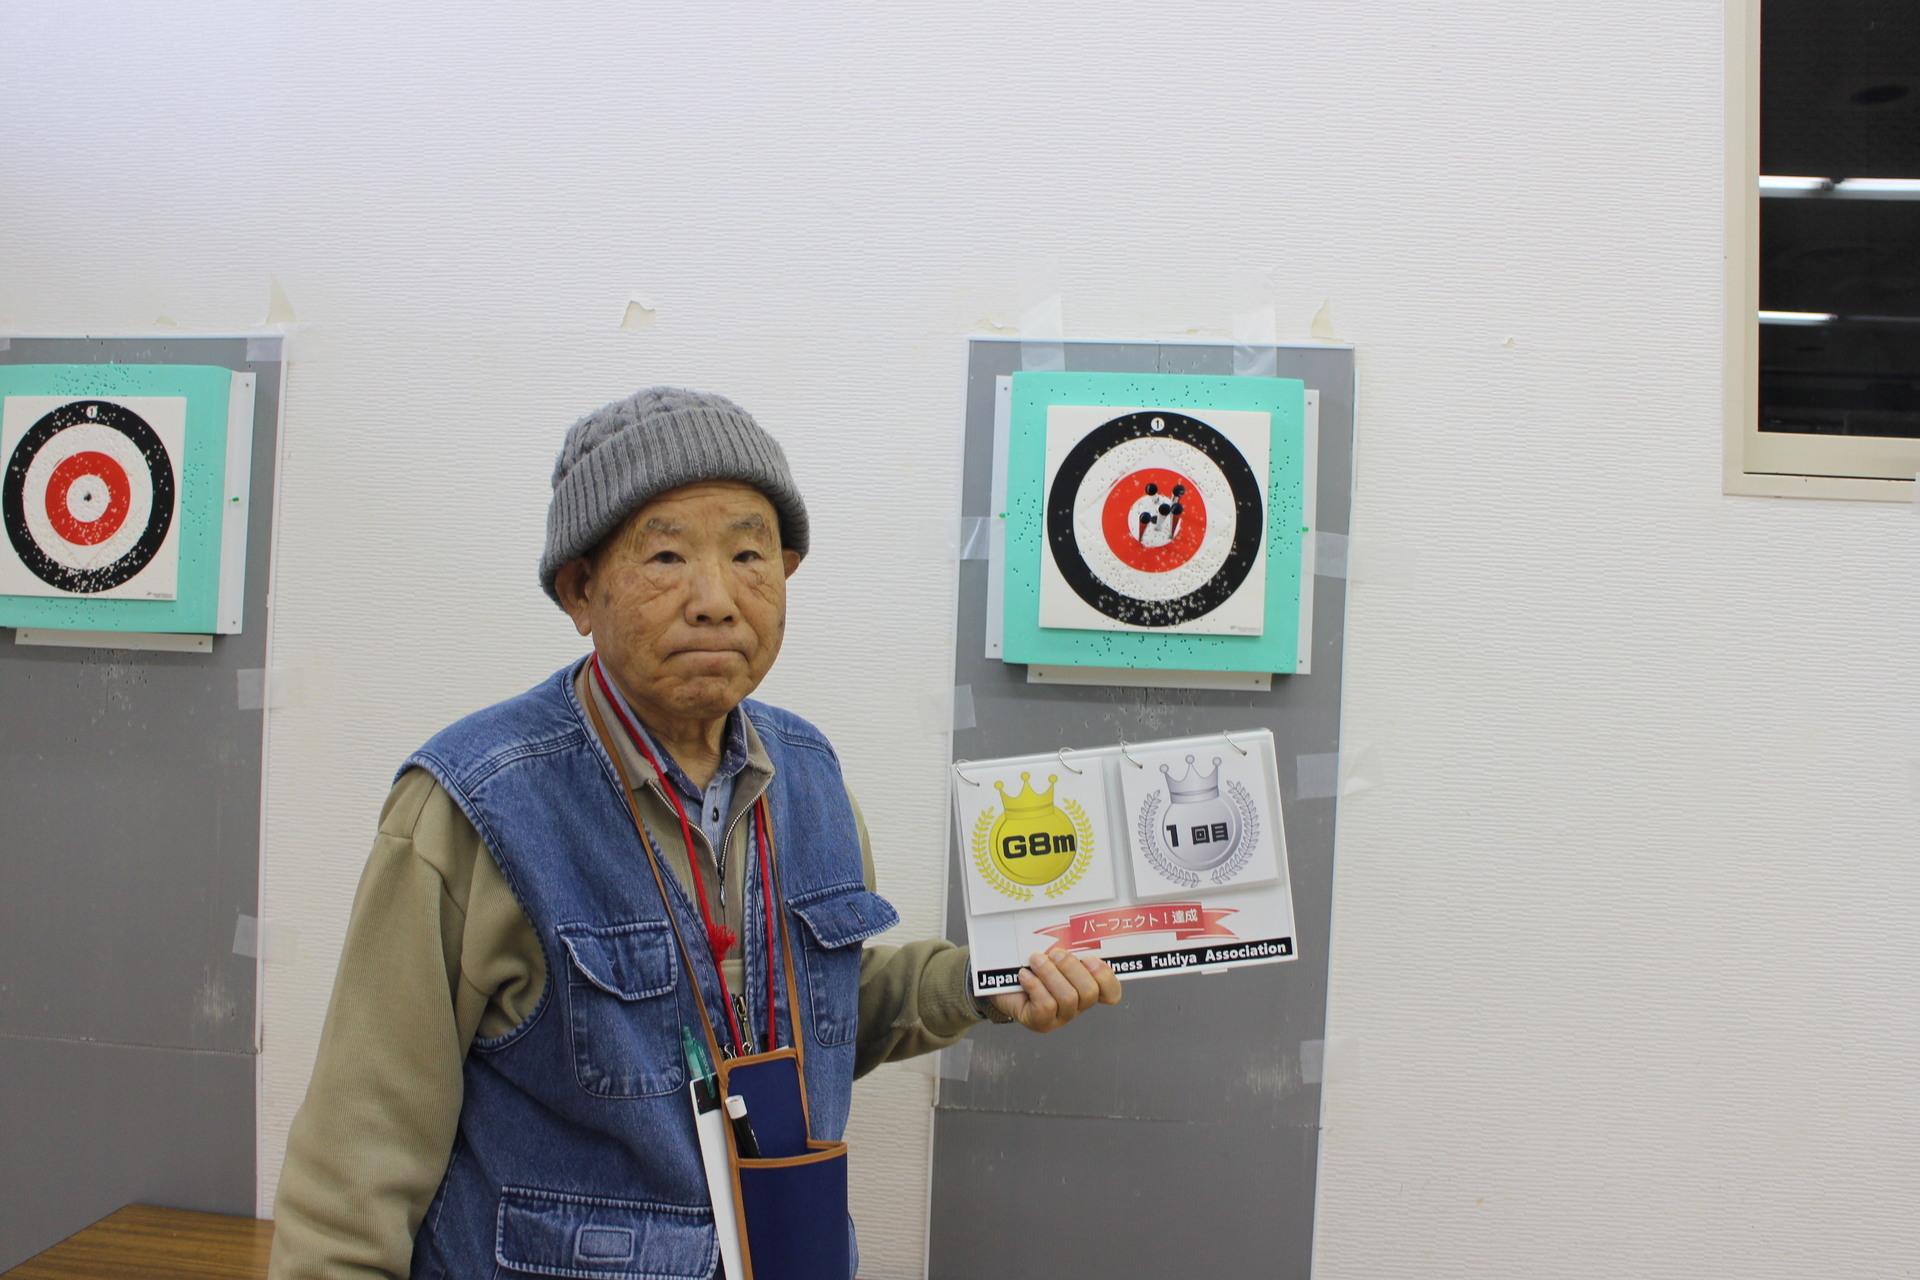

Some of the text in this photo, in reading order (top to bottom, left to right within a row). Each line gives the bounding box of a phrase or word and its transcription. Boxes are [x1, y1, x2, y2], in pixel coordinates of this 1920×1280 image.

[1002, 832, 1076, 859] G8m
[1166, 822, 1229, 847] 1 回目
[1151, 953, 1197, 968] Fukiya
[1205, 942, 1287, 962] Association
